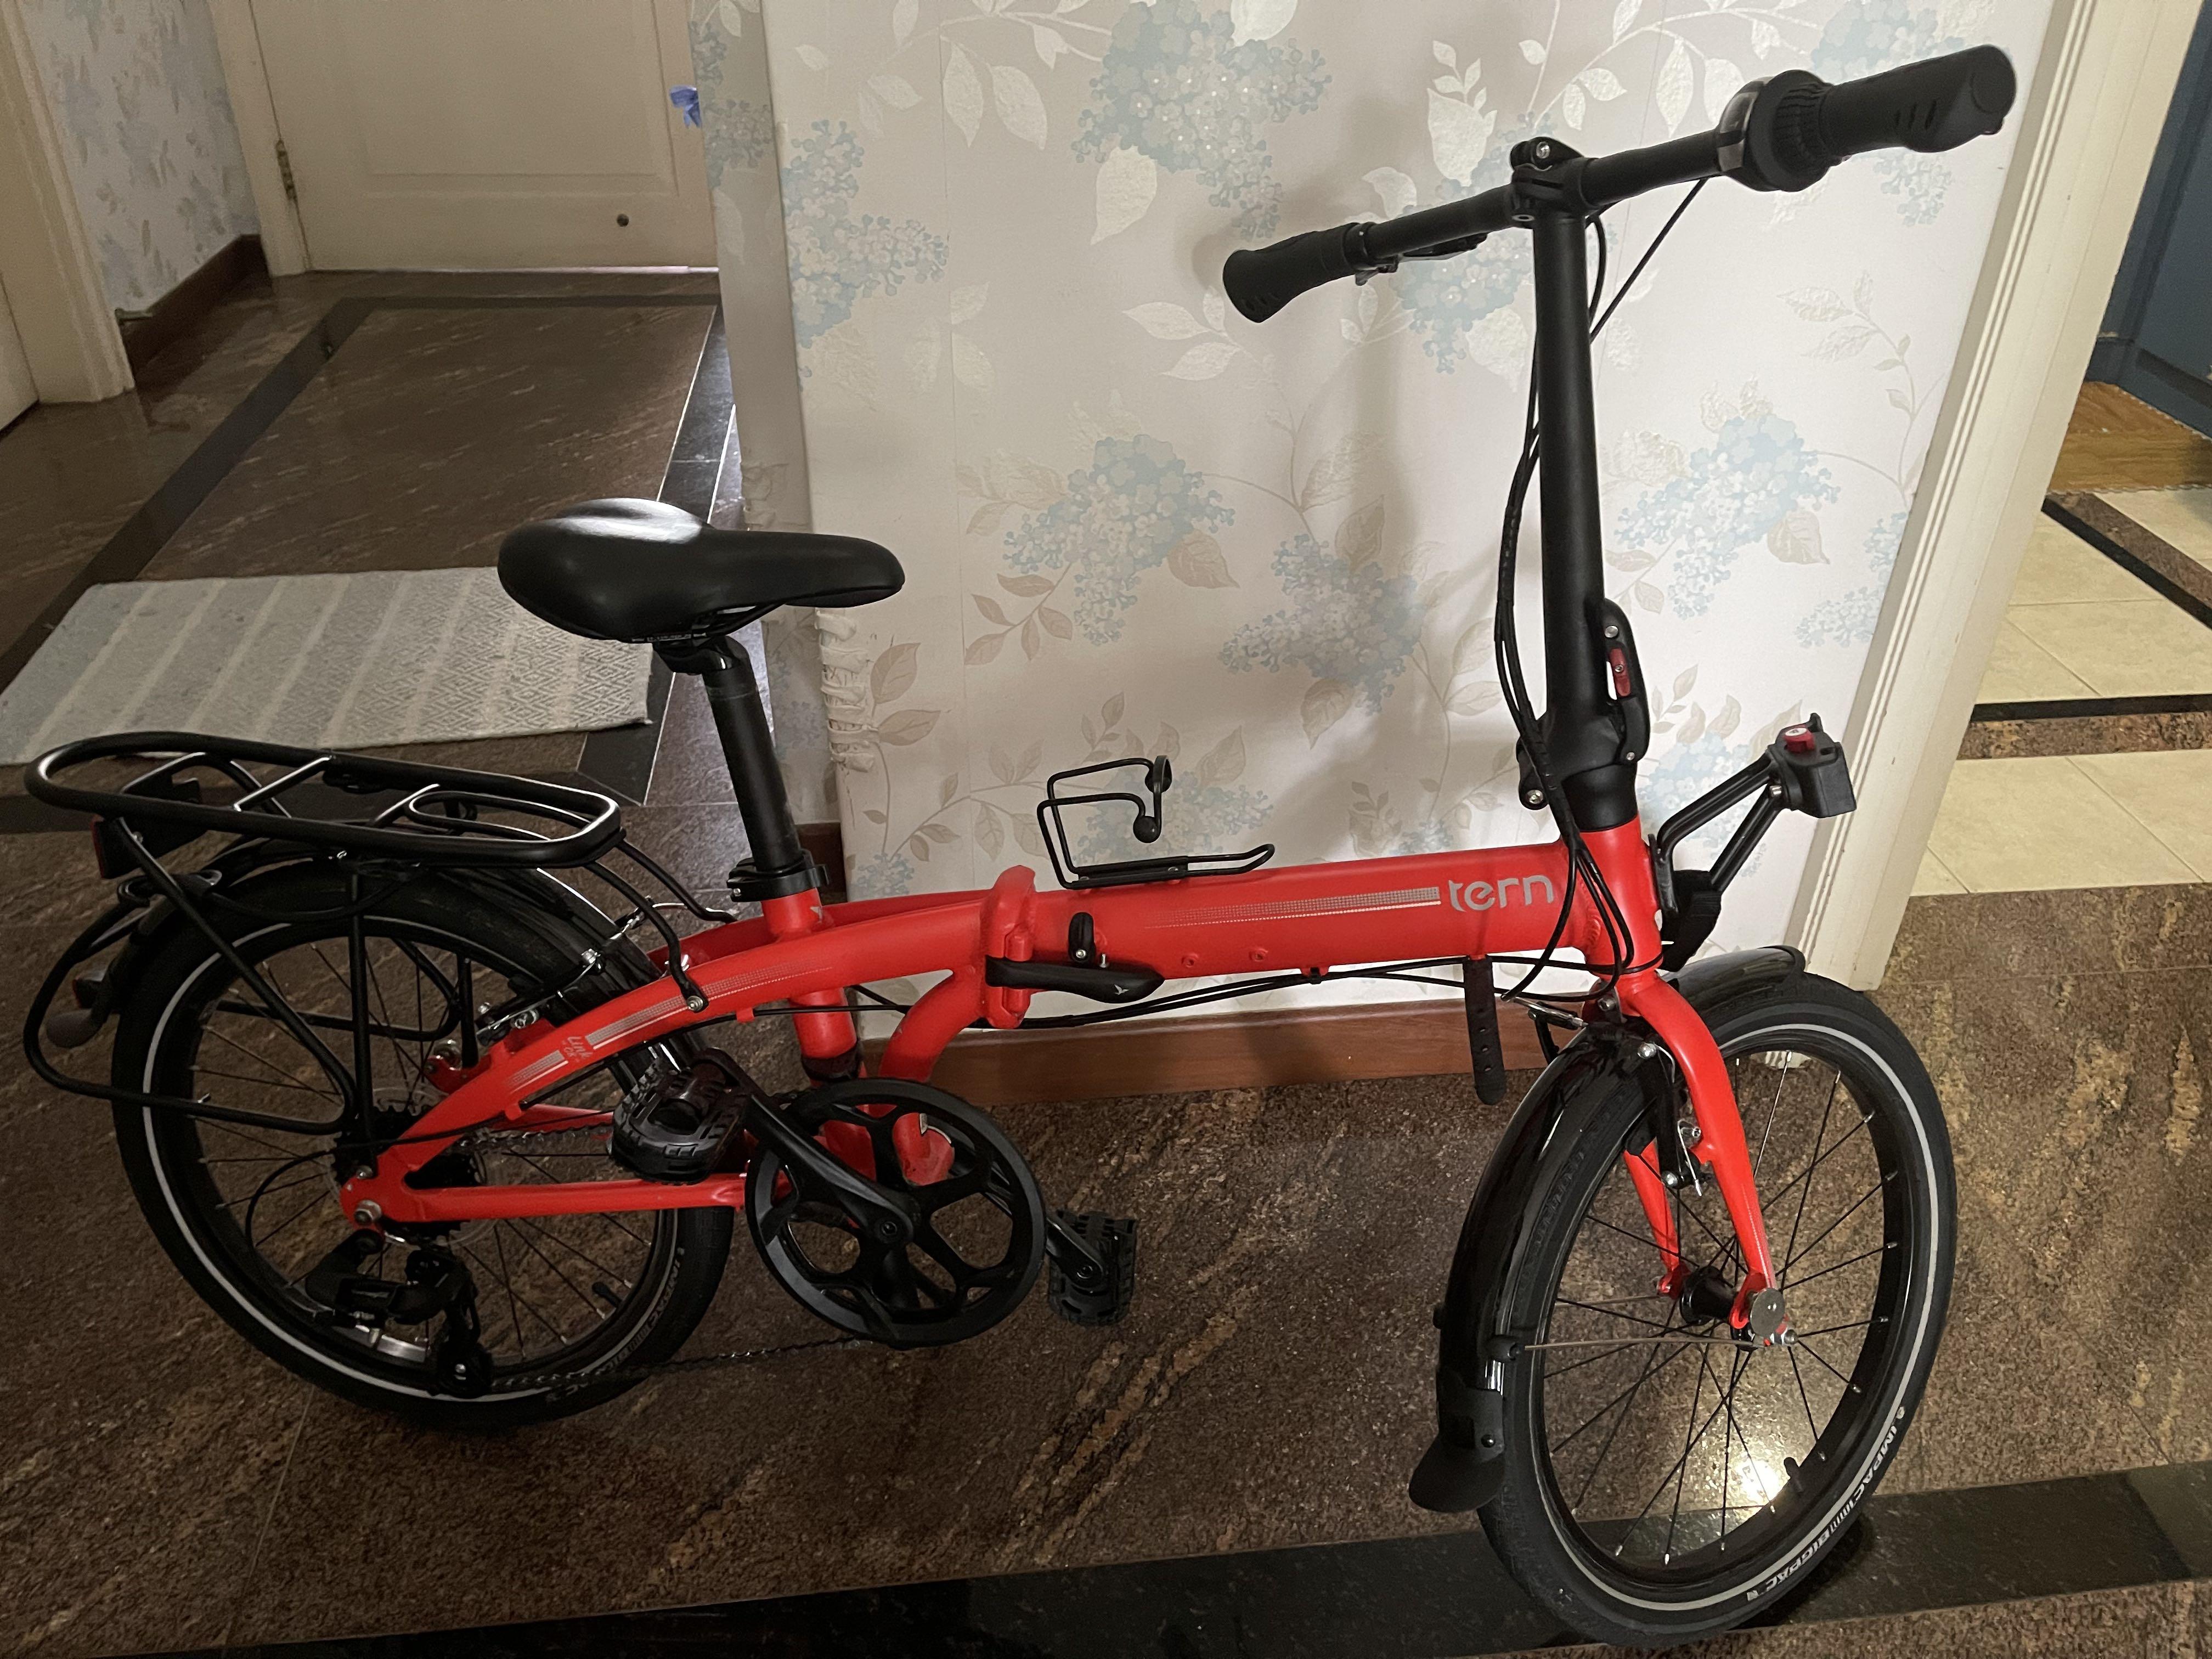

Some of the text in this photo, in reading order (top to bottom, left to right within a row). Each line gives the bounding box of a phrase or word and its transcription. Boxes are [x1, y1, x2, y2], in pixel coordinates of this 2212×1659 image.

[1448, 874, 1554, 912] tern
[1765, 1425, 1897, 1592] IMPAC BIGPAC
